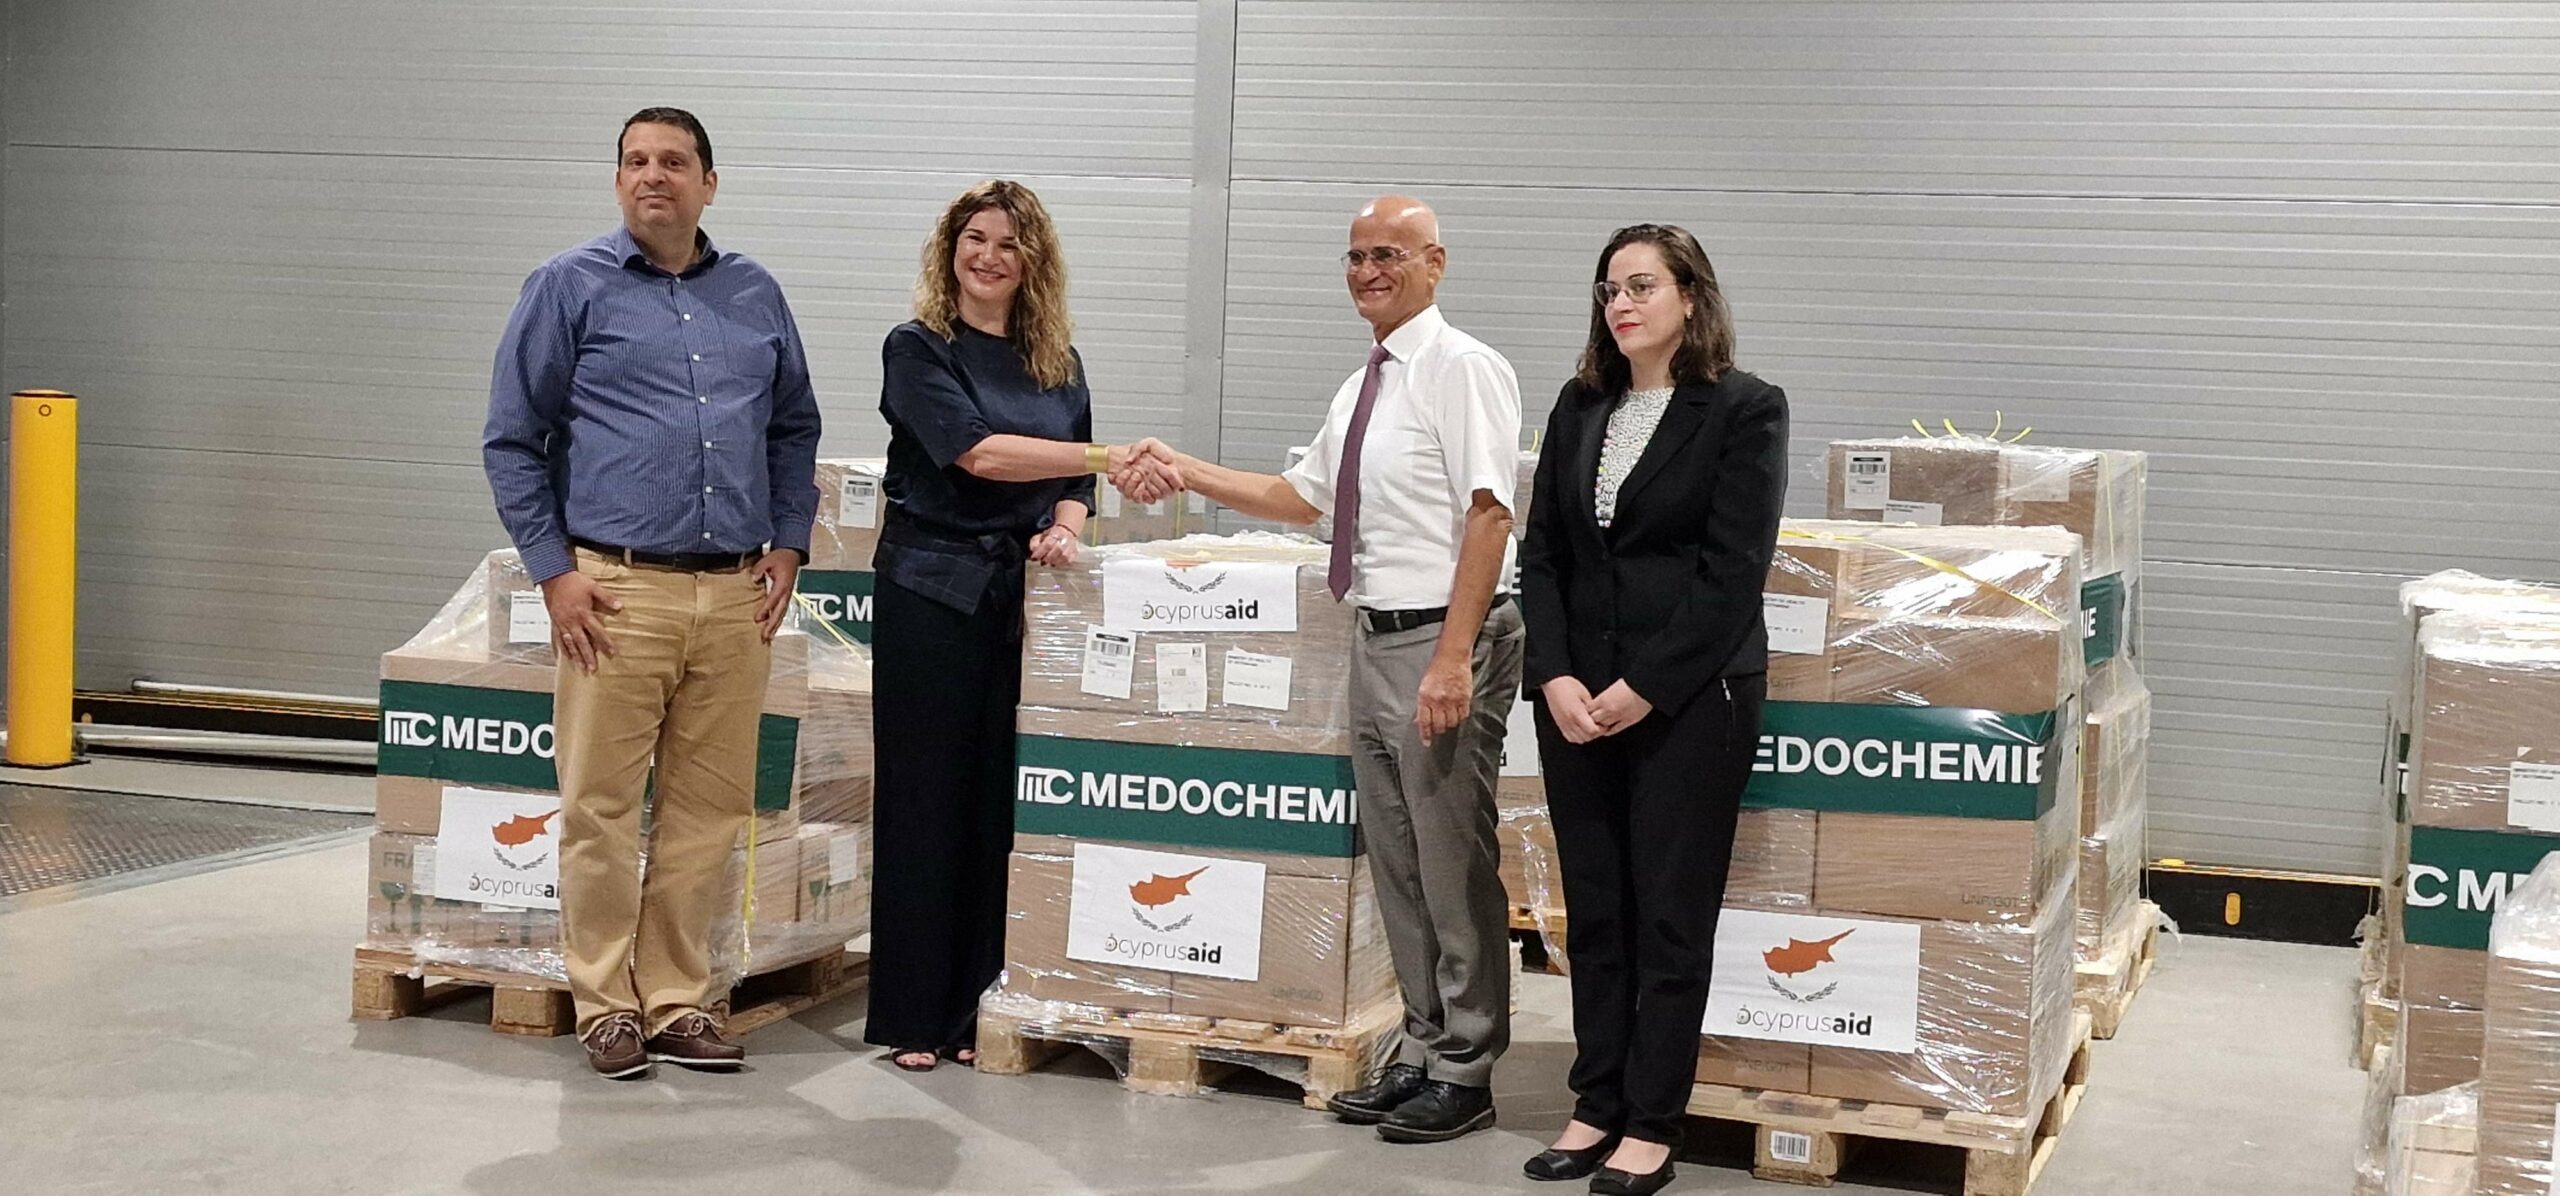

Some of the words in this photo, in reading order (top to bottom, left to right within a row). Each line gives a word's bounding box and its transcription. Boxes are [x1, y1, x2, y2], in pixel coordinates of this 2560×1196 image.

[442, 715, 556, 759] MEDO
[1081, 772, 1357, 825] MEDOCHEMI
[2458, 868, 2532, 912] M
